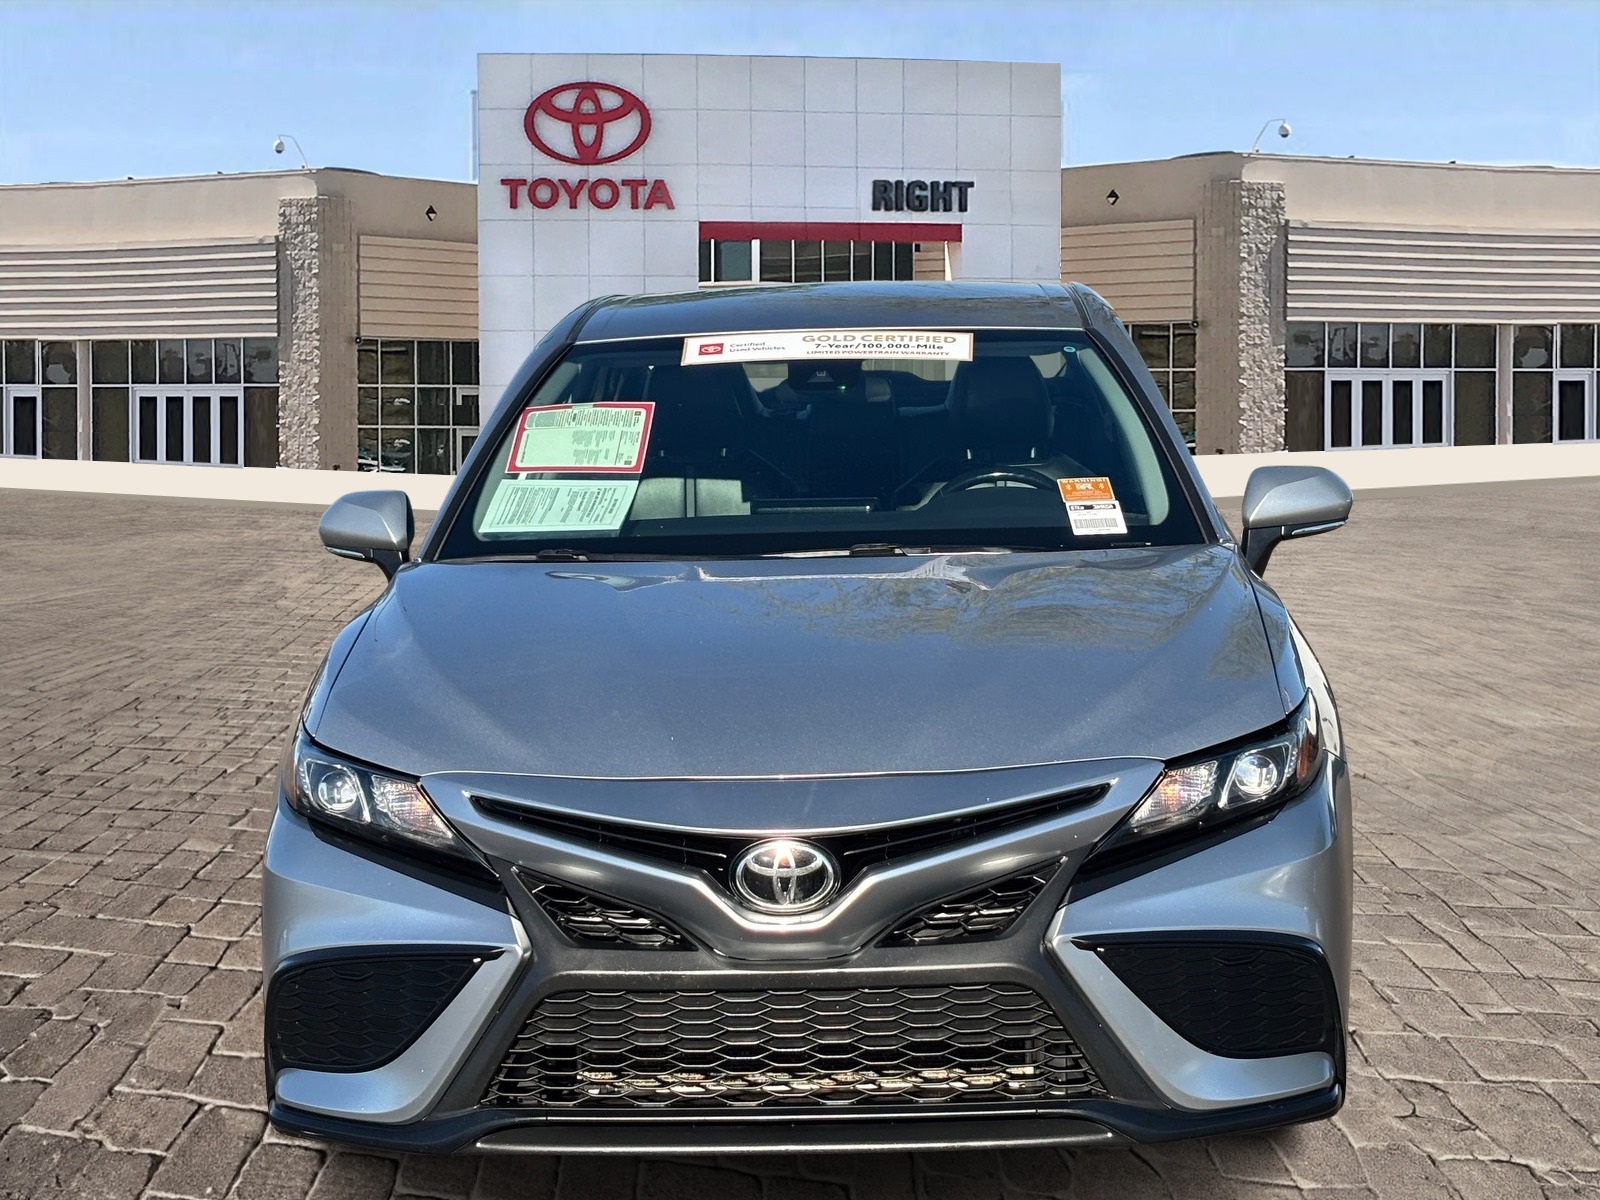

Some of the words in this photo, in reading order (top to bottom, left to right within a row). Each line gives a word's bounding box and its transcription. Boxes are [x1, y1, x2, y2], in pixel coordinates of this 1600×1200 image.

[501, 178, 675, 210] TOYOTA
[872, 180, 975, 213] RIGHT
[802, 335, 857, 343] GOLD
[861, 335, 957, 343] CERTIFIED
[813, 342, 944, 350] 7-Year/100,000-Mile
